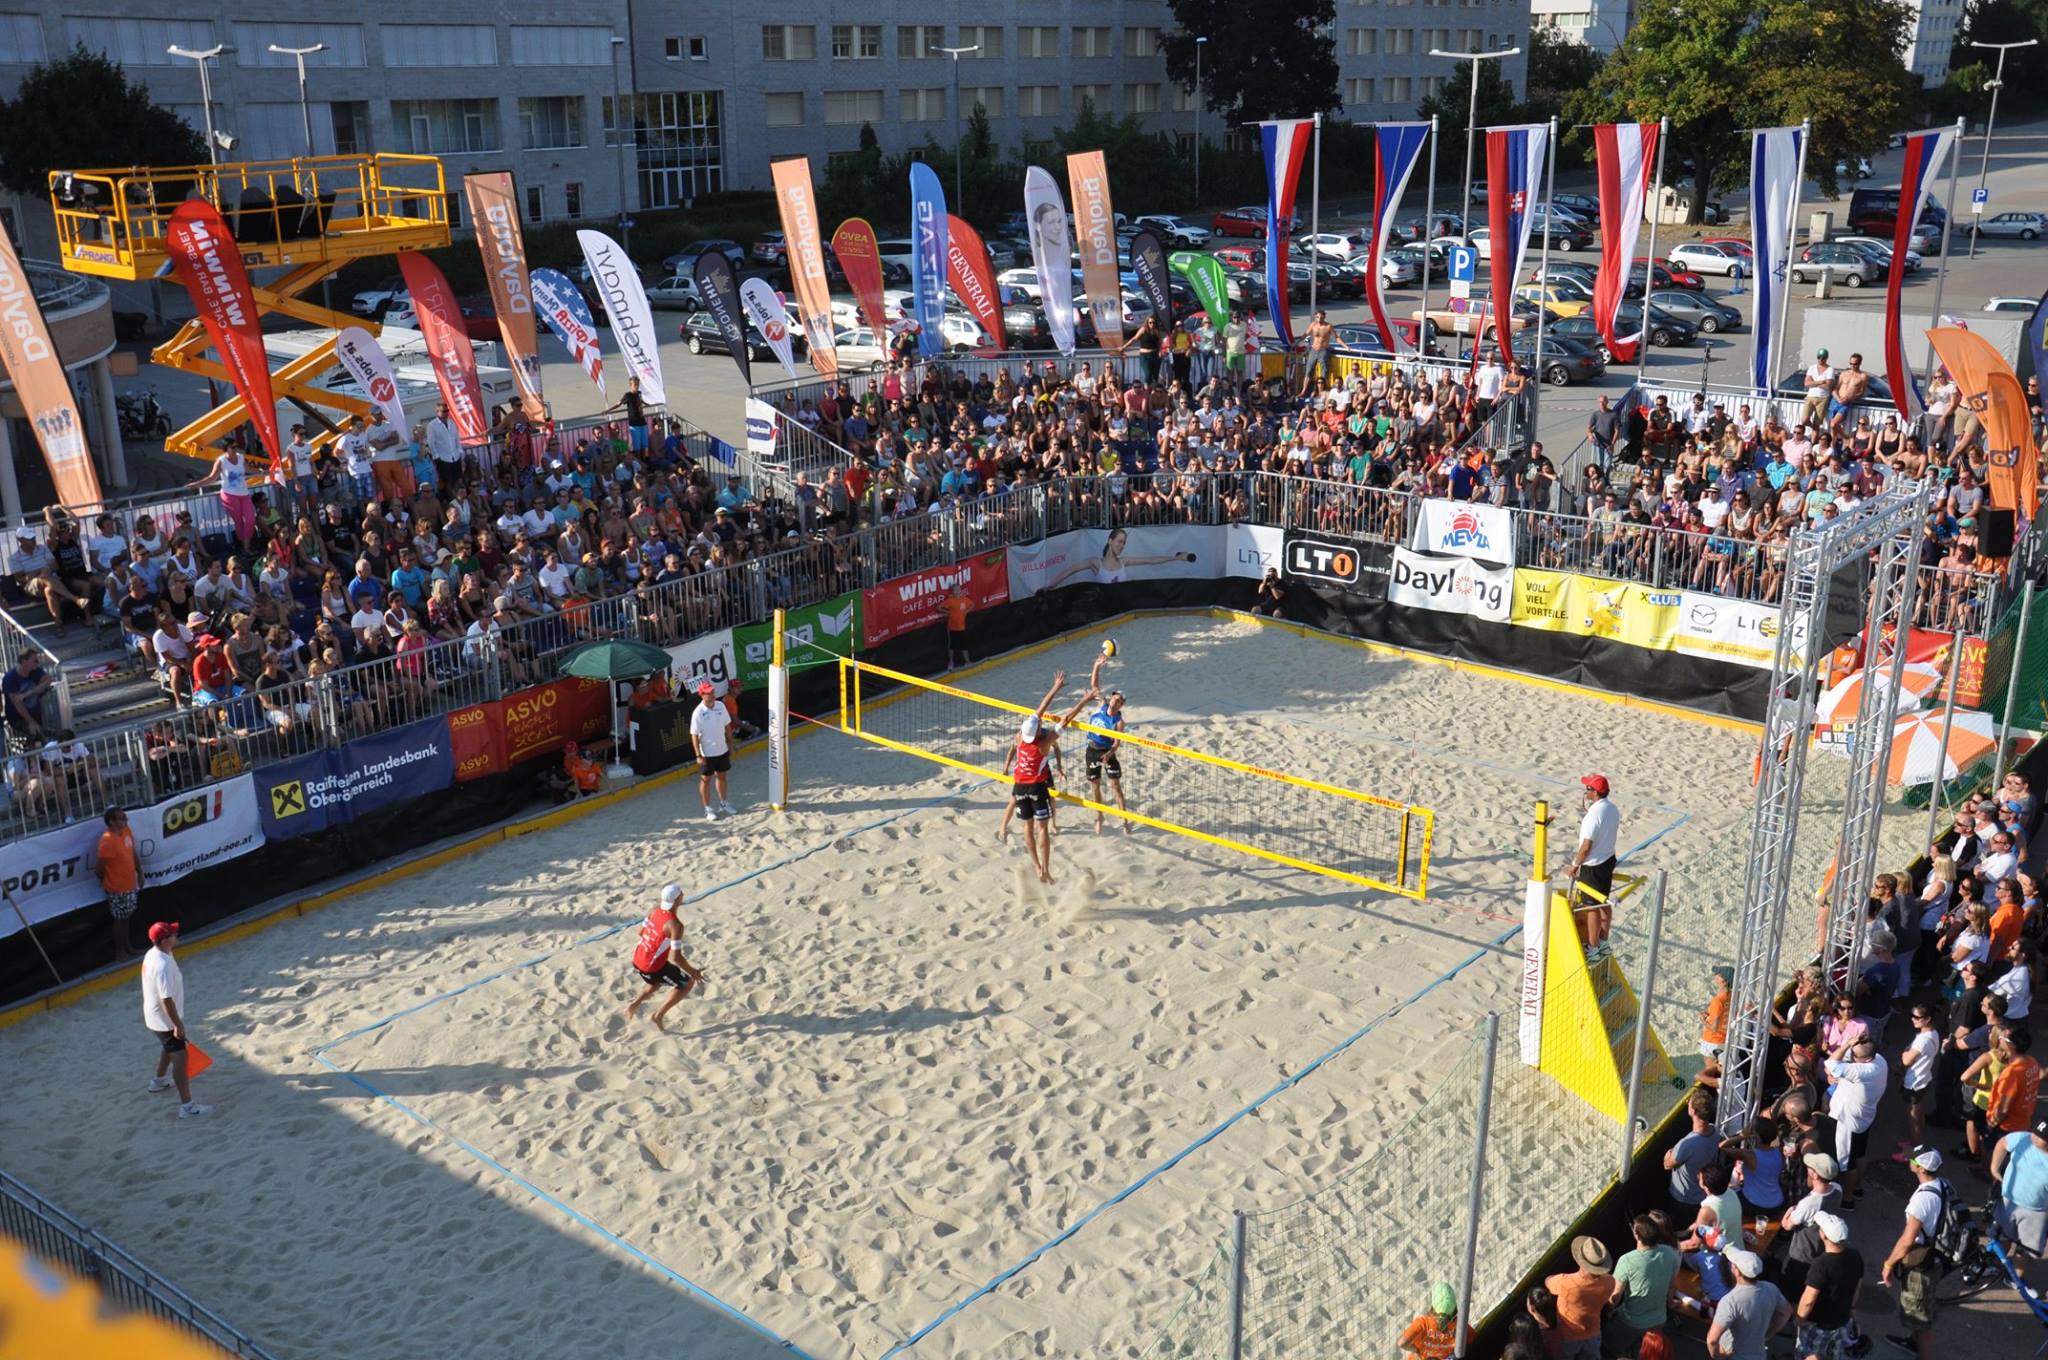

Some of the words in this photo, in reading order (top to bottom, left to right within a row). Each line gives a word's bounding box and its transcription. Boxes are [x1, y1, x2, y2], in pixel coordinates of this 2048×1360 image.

[1455, 249, 1470, 278] P
[948, 249, 995, 320] GENERALI
[1295, 546, 1353, 577] LT1
[1526, 582, 1551, 593] VOLL.
[1526, 595, 1547, 605] VIEL.
[1526, 606, 1569, 620] VORTEILE.
[363, 743, 439, 777] Landesbank
[1522, 947, 1540, 1018] GENERALI
